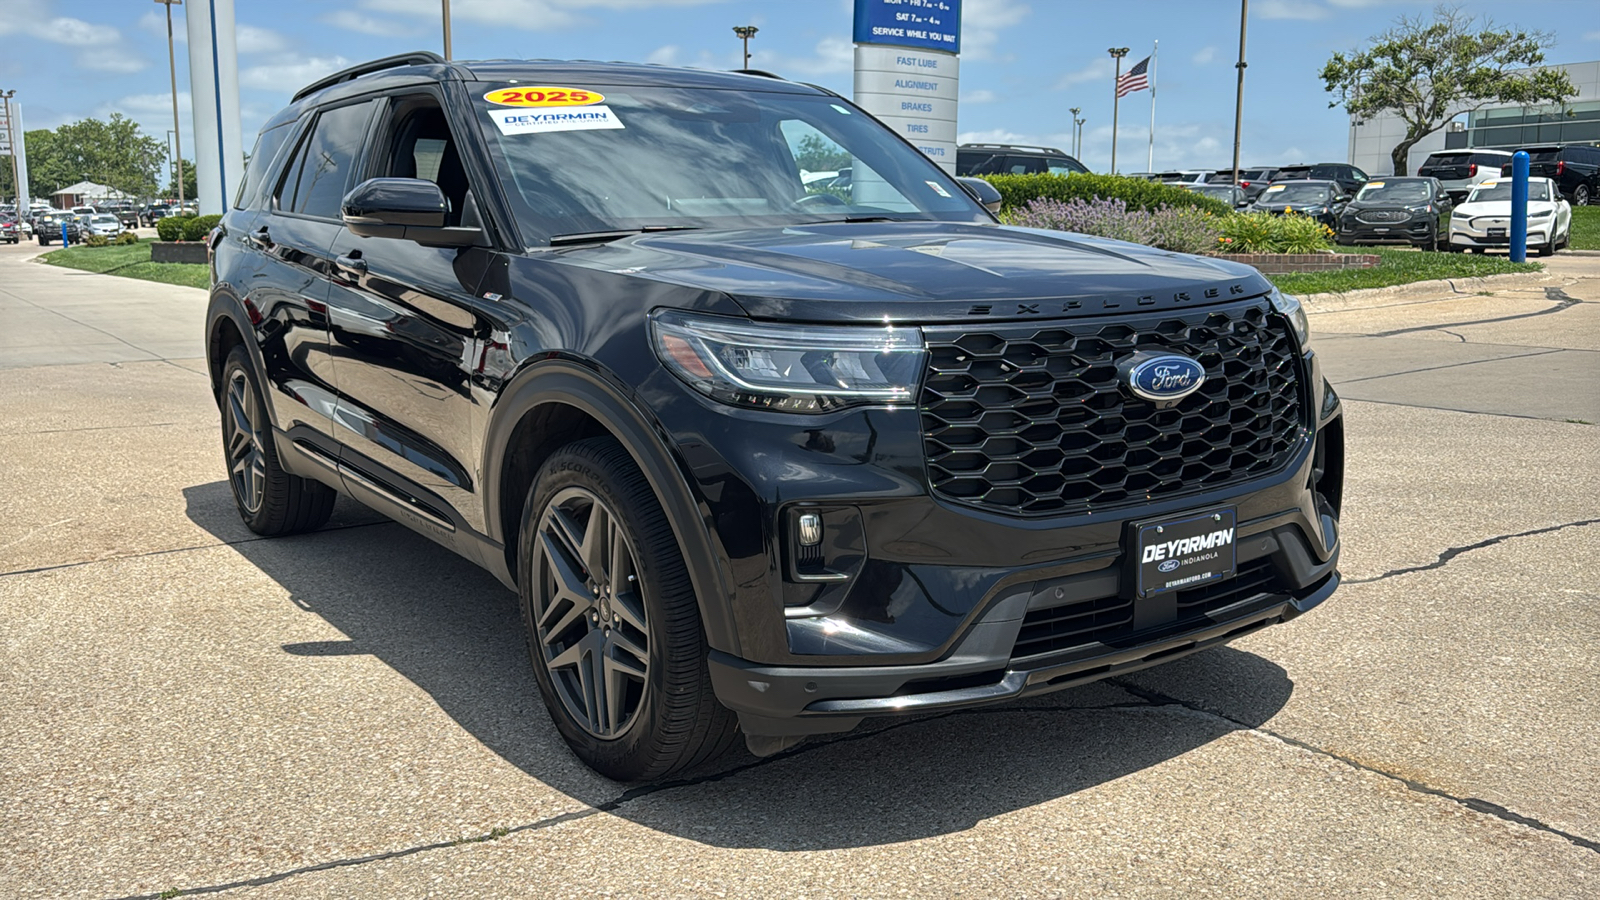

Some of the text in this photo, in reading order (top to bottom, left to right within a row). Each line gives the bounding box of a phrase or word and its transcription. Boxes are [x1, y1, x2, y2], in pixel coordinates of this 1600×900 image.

[896, 12, 909, 21] SAT
[872, 27, 956, 43] SERVICE WHILE YOU WAIT
[897, 56, 937, 68] FAST LUBE
[895, 79, 938, 91] ALIGNMENT
[502, 91, 590, 102] 2025
[901, 102, 932, 112] BRAKES
[504, 113, 607, 123] DEYARMAN
[907, 124, 928, 133] TIRES
[967, 283, 1245, 316] EXPLORER
[1152, 364, 1191, 390] Ford
[1142, 528, 1234, 564] DEYARMAN
[1181, 551, 1218, 566] INDIANOLA
[1165, 572, 1212, 588] DEYARMANFORD.COM
